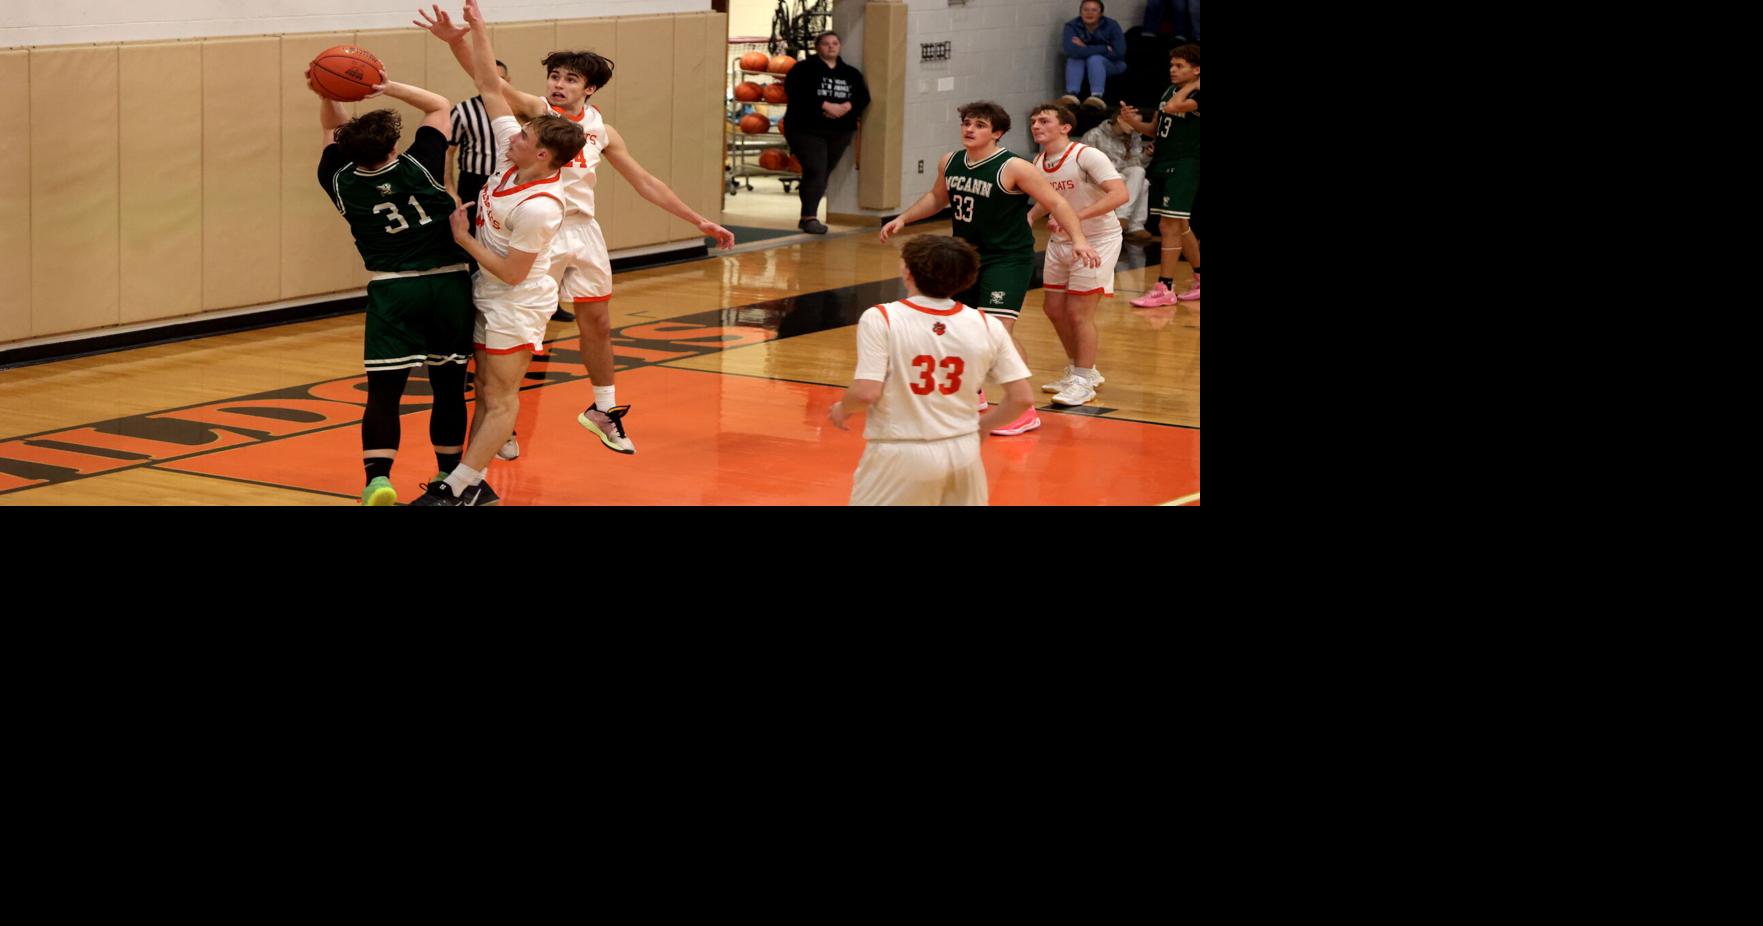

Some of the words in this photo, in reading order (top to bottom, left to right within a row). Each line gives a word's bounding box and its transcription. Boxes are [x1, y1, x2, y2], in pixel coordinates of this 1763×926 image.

[562, 148, 587, 168] 4
[372, 195, 433, 234] 31
[953, 194, 974, 222] 33
[909, 354, 965, 396] 33
